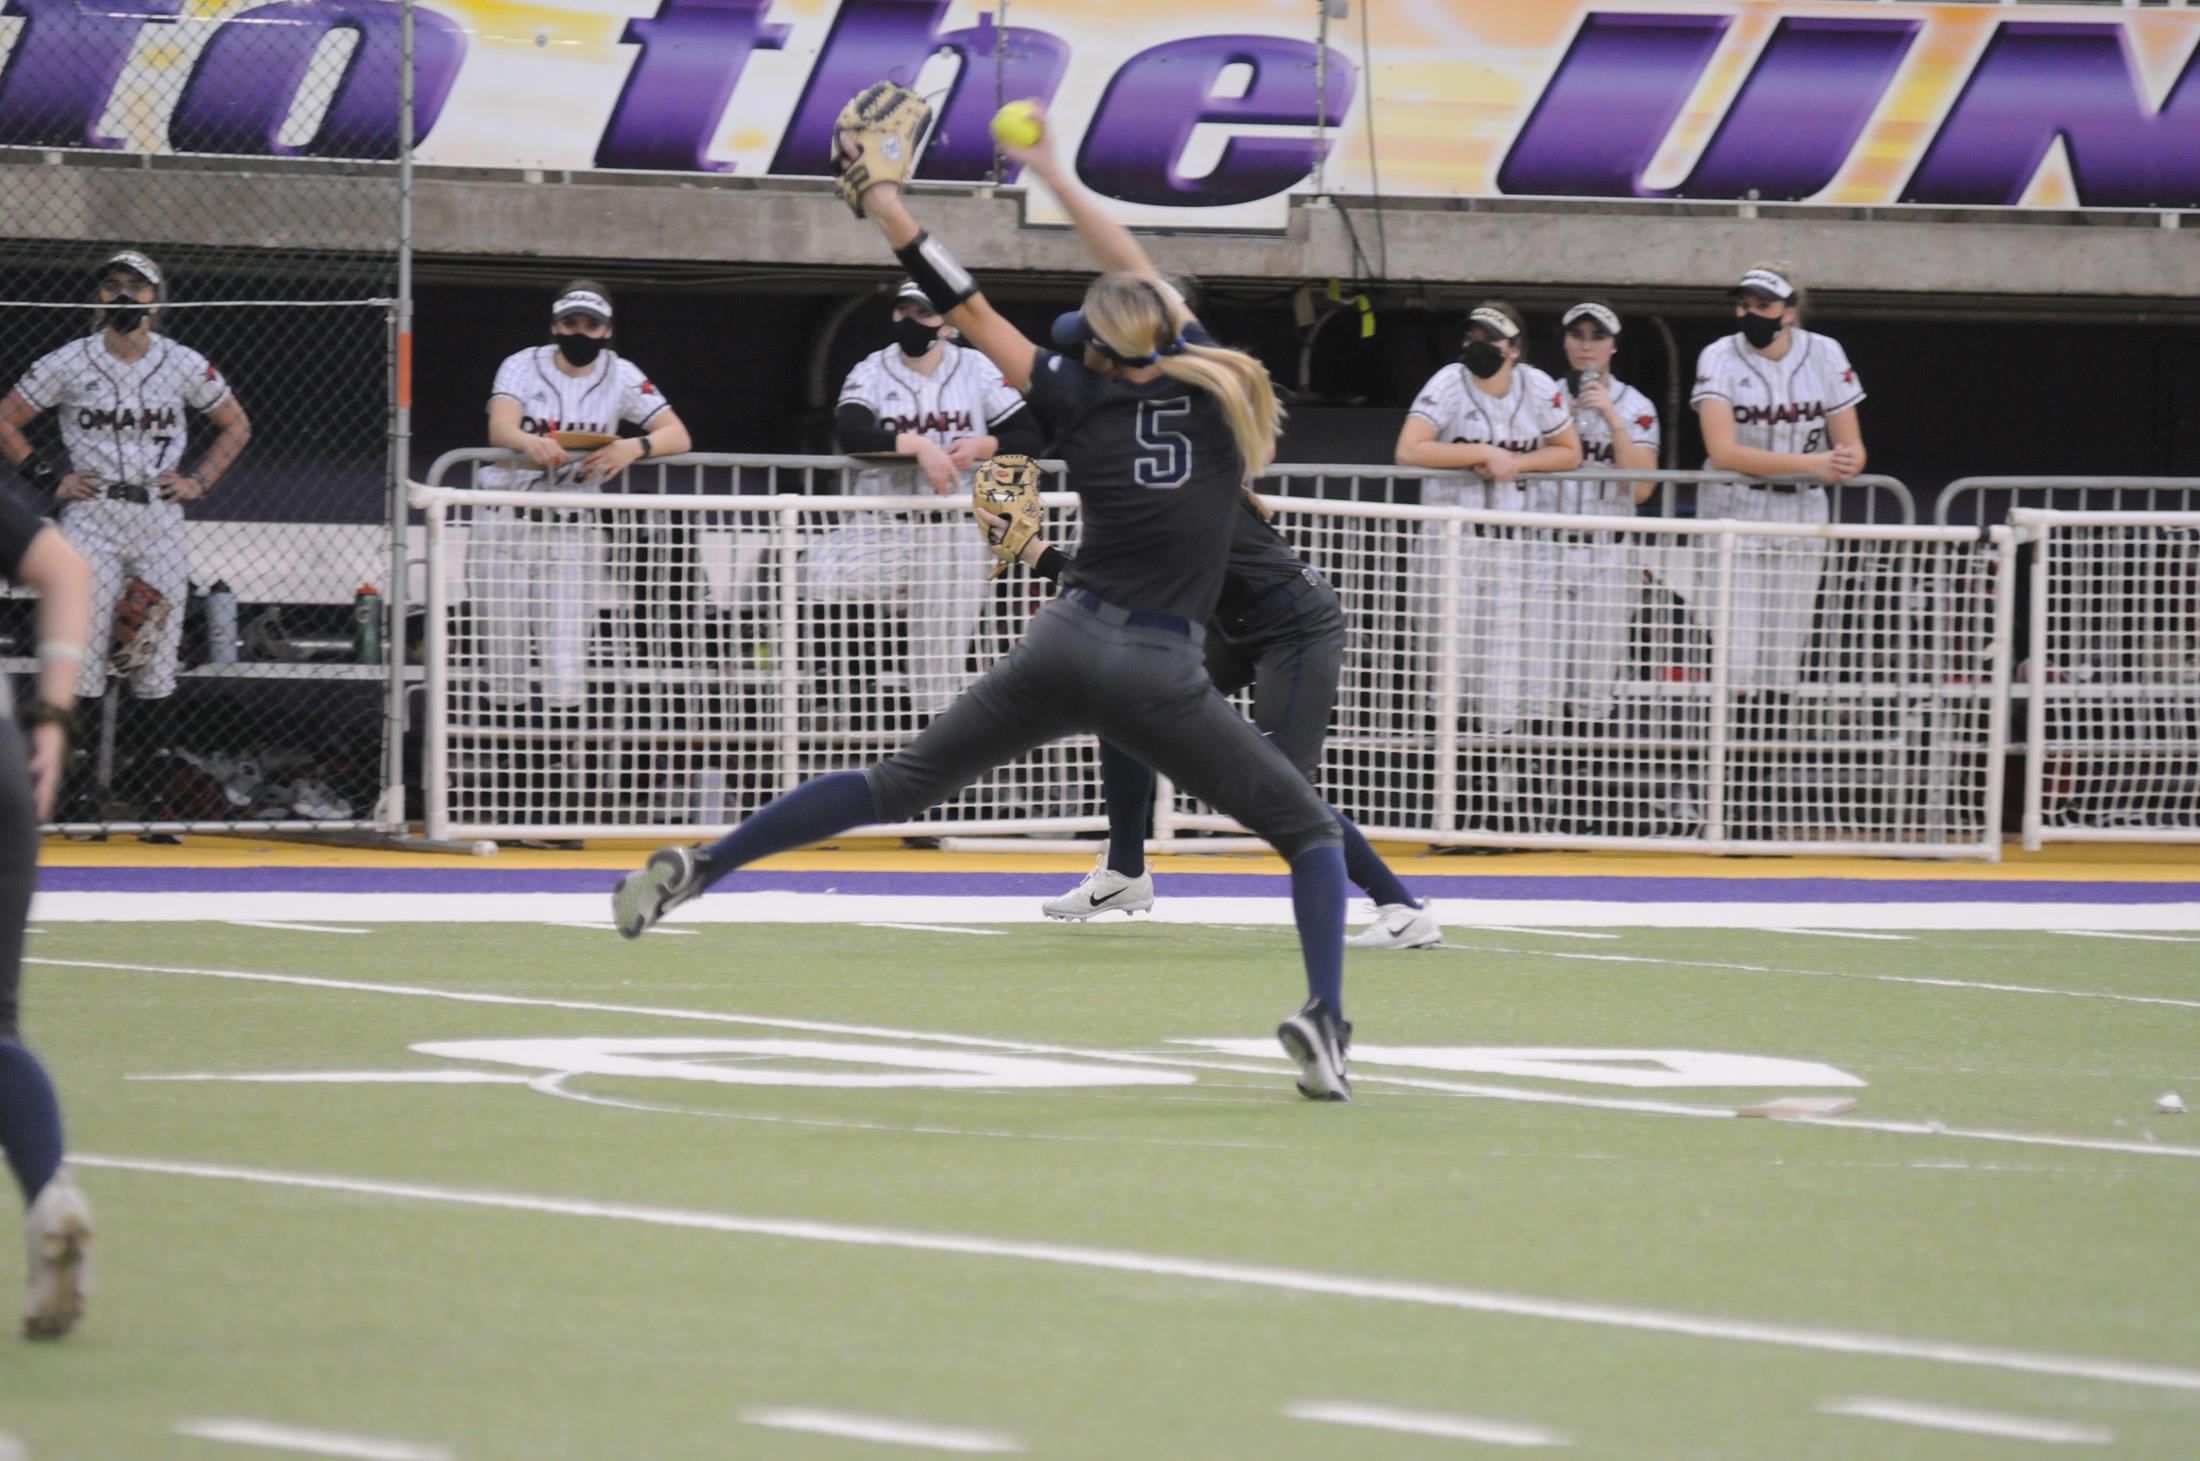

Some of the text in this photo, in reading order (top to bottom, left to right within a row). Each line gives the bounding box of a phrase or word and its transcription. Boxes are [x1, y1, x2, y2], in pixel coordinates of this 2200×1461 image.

[594, 0, 1357, 207] the
[79, 408, 176, 430] OMAHA
[881, 411, 974, 433] OMAHA
[1733, 401, 1826, 425] OMAHA
[152, 435, 173, 469] 7
[1134, 396, 1193, 489] 5
[1802, 426, 1822, 454] 8
